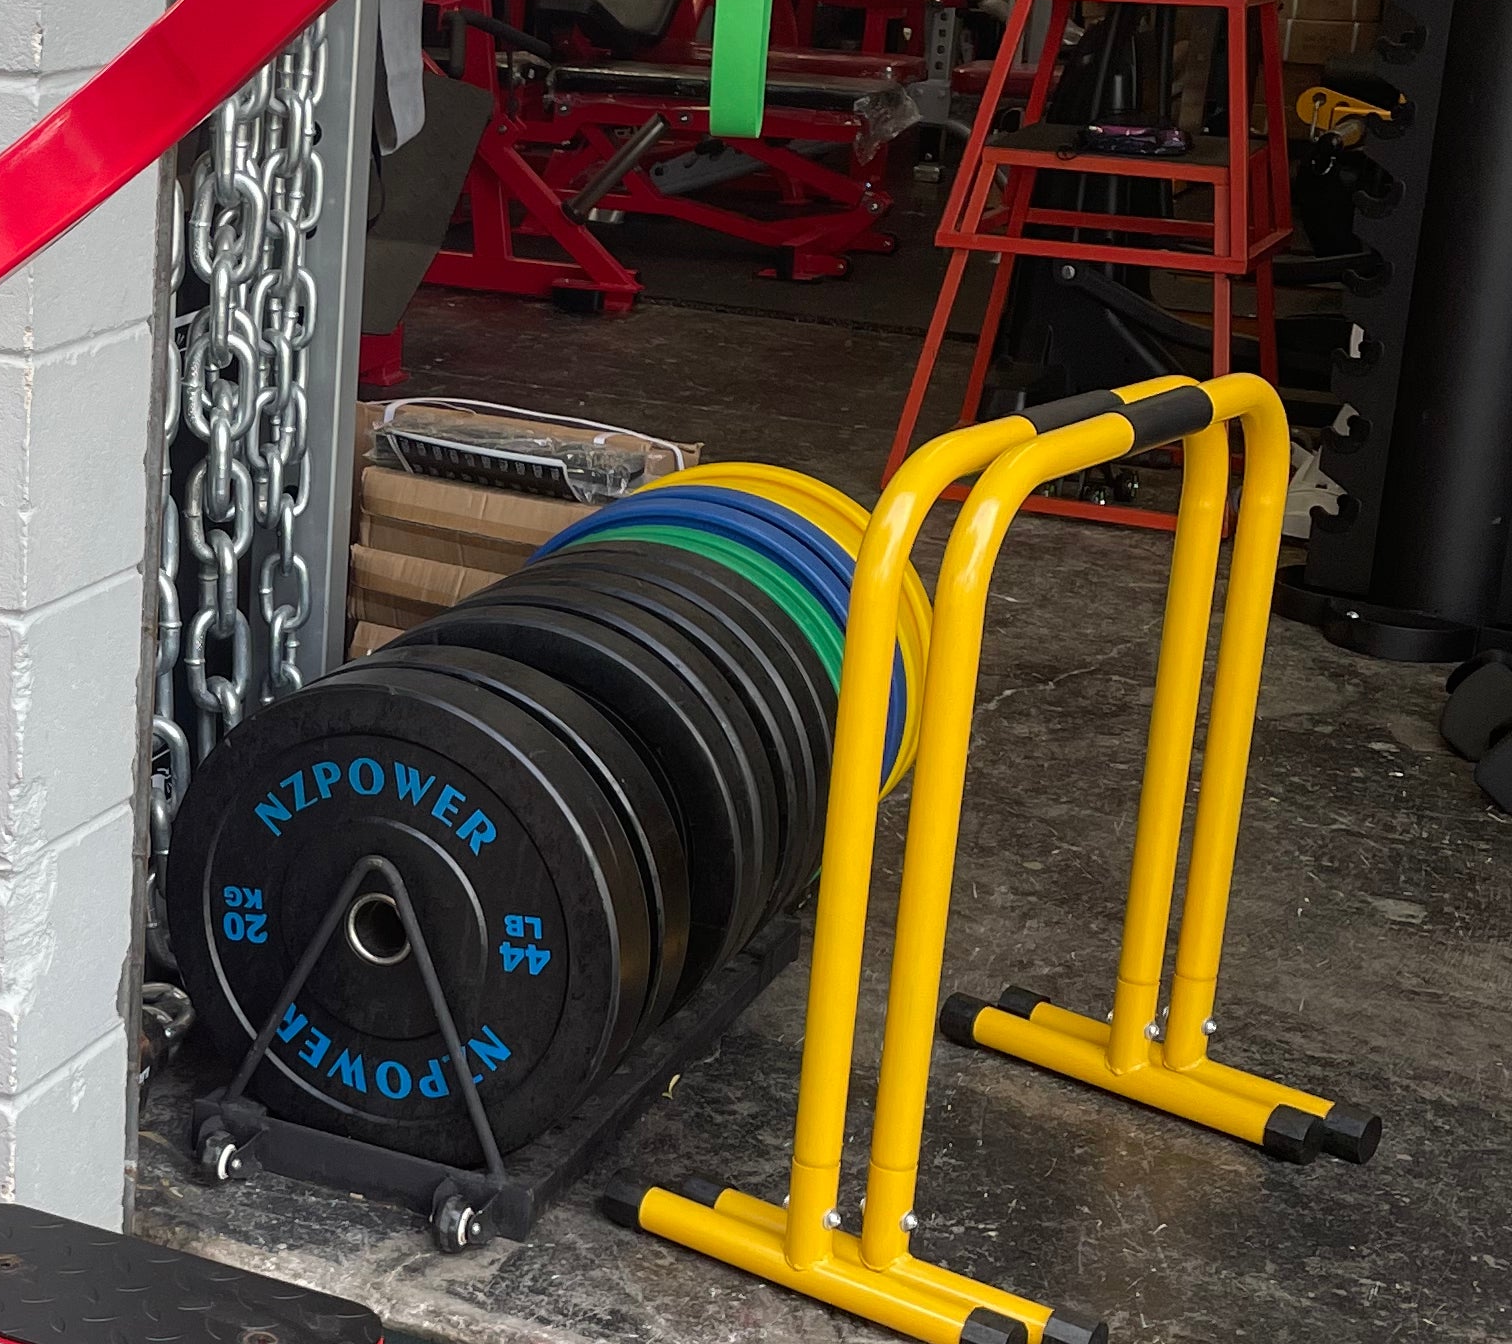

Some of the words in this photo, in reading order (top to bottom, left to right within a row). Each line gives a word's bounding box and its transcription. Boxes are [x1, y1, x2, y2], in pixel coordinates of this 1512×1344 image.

[254, 757, 498, 856] NZPOWER
[223, 885, 263, 910] KG
[223, 911, 268, 944] 20
[503, 914, 543, 940] LB
[499, 941, 551, 977] 44
[276, 1003, 512, 1100] NPOWER
